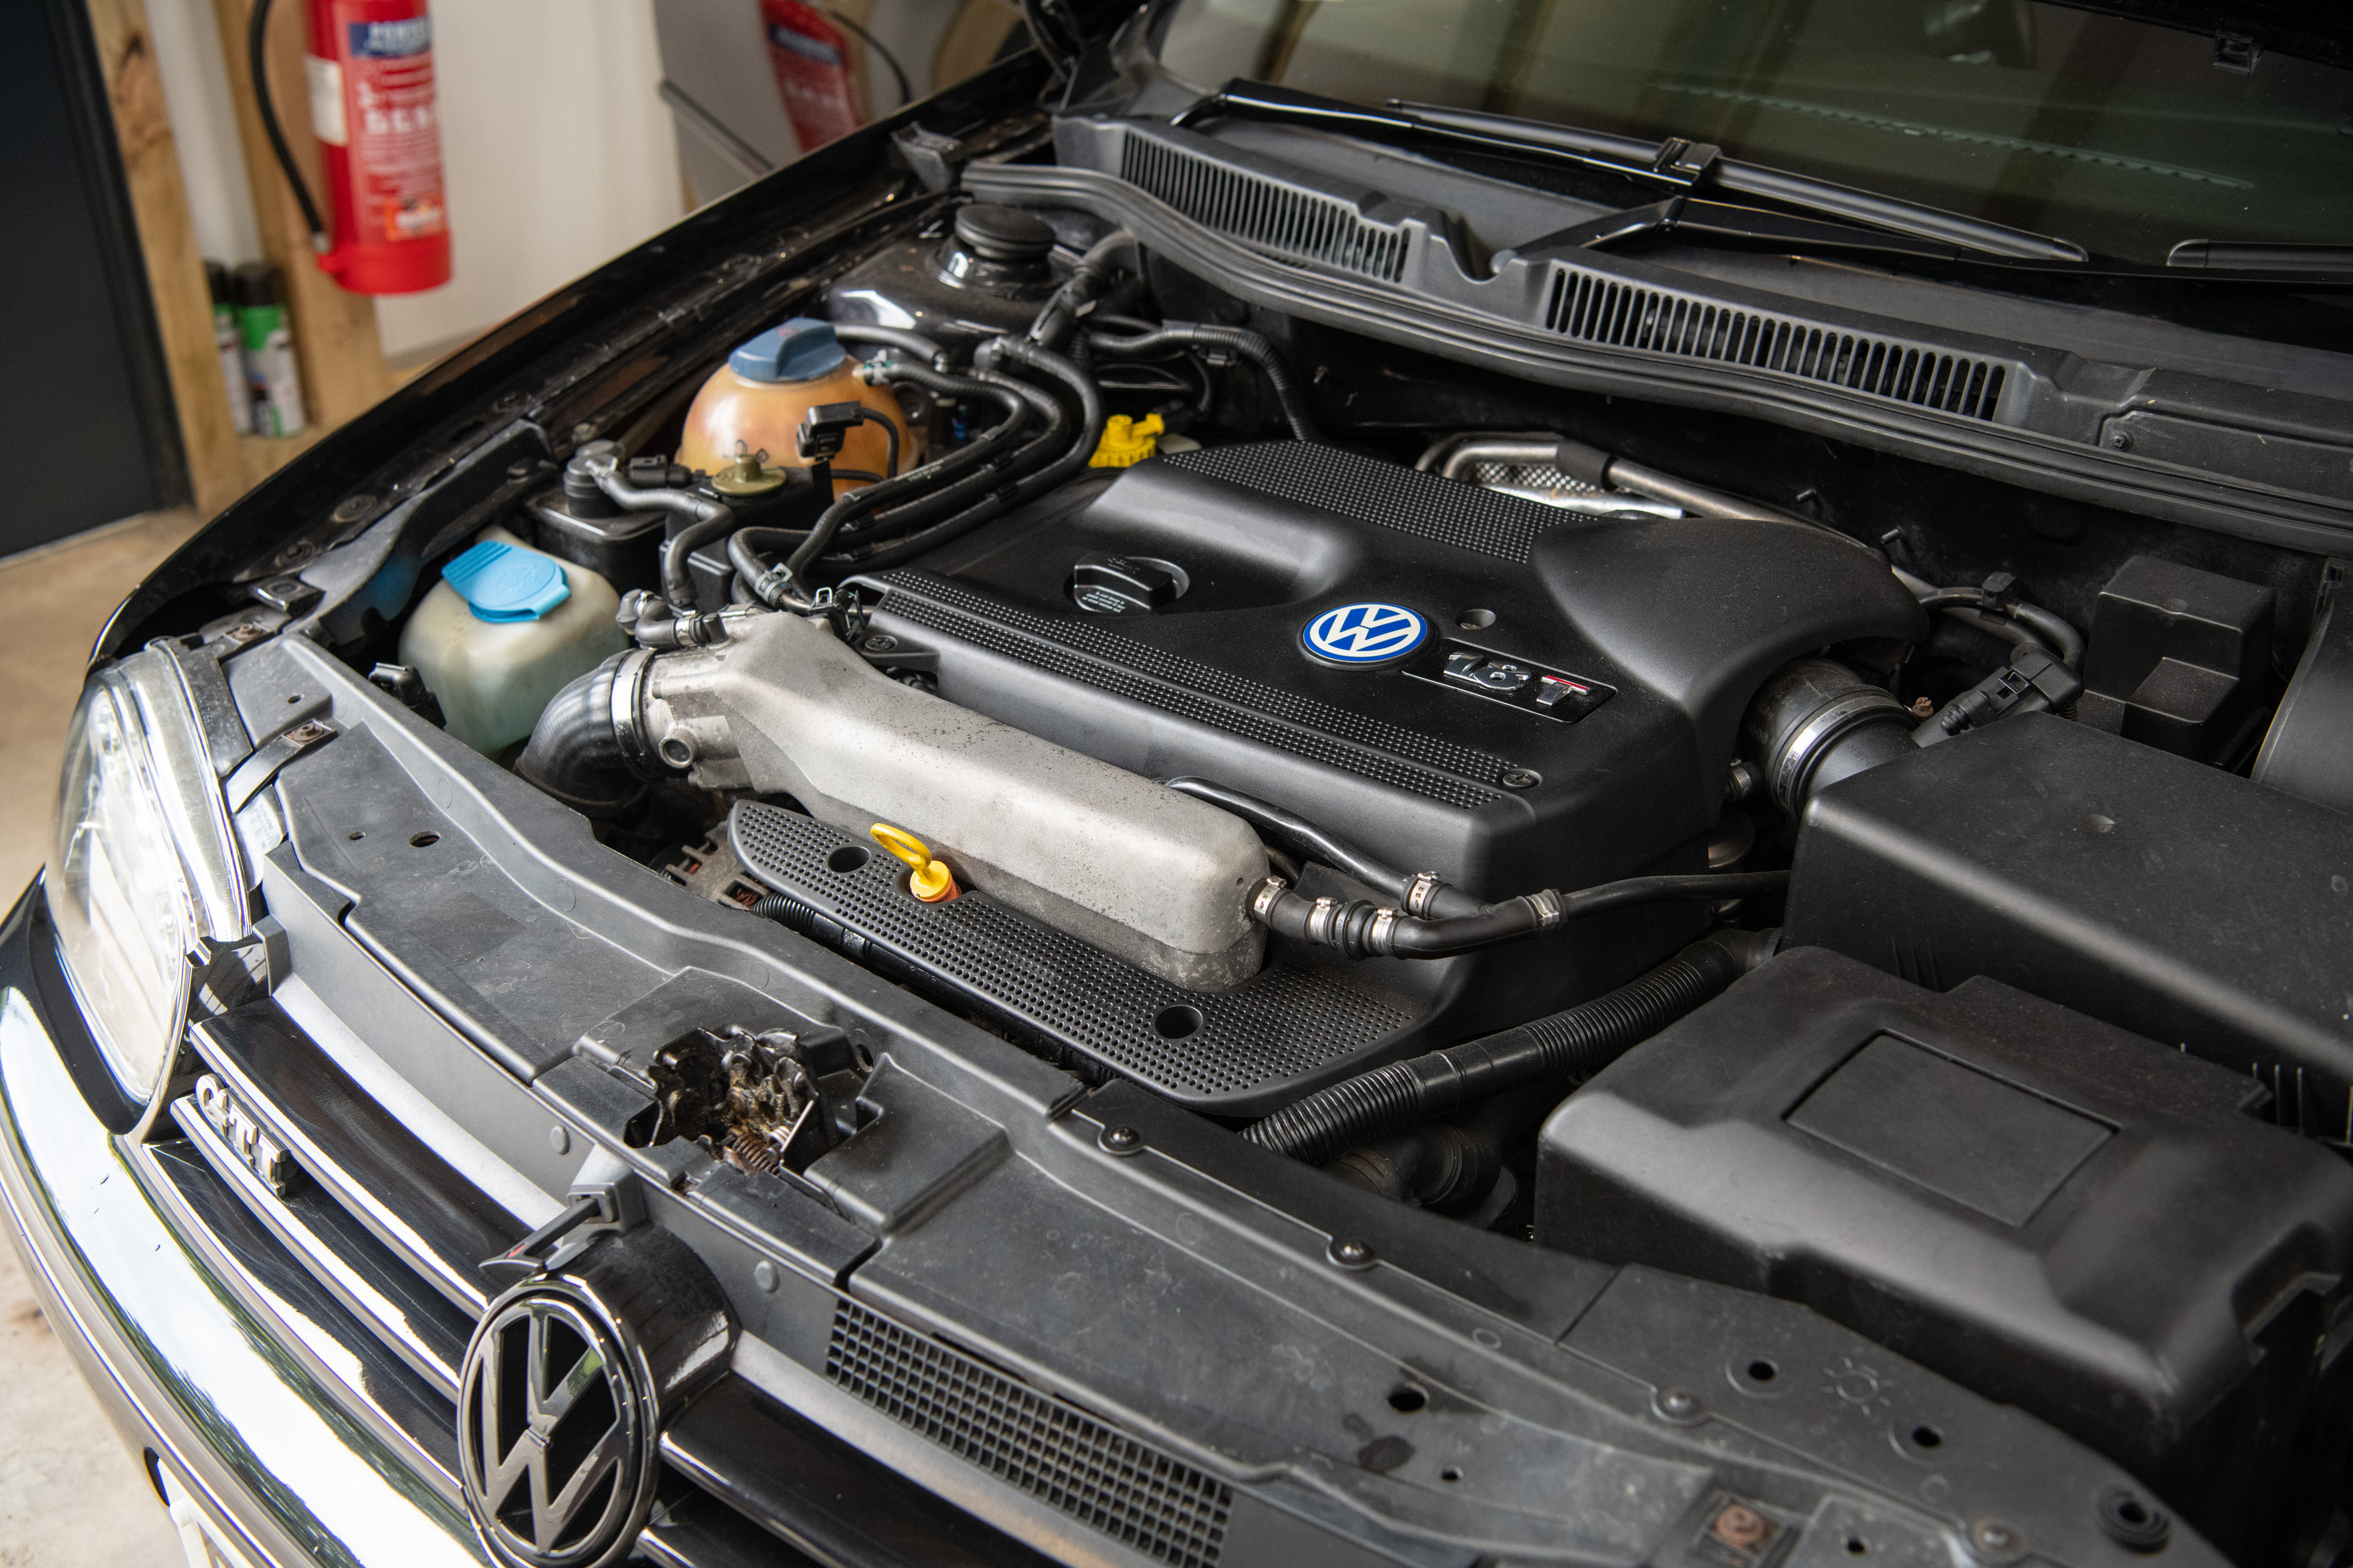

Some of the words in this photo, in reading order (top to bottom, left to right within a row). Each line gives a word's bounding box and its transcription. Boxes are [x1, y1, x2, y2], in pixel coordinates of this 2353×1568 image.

[1309, 604, 1421, 658] VW
[195, 1073, 283, 1194] GTI
[461, 1298, 636, 1565] VW
